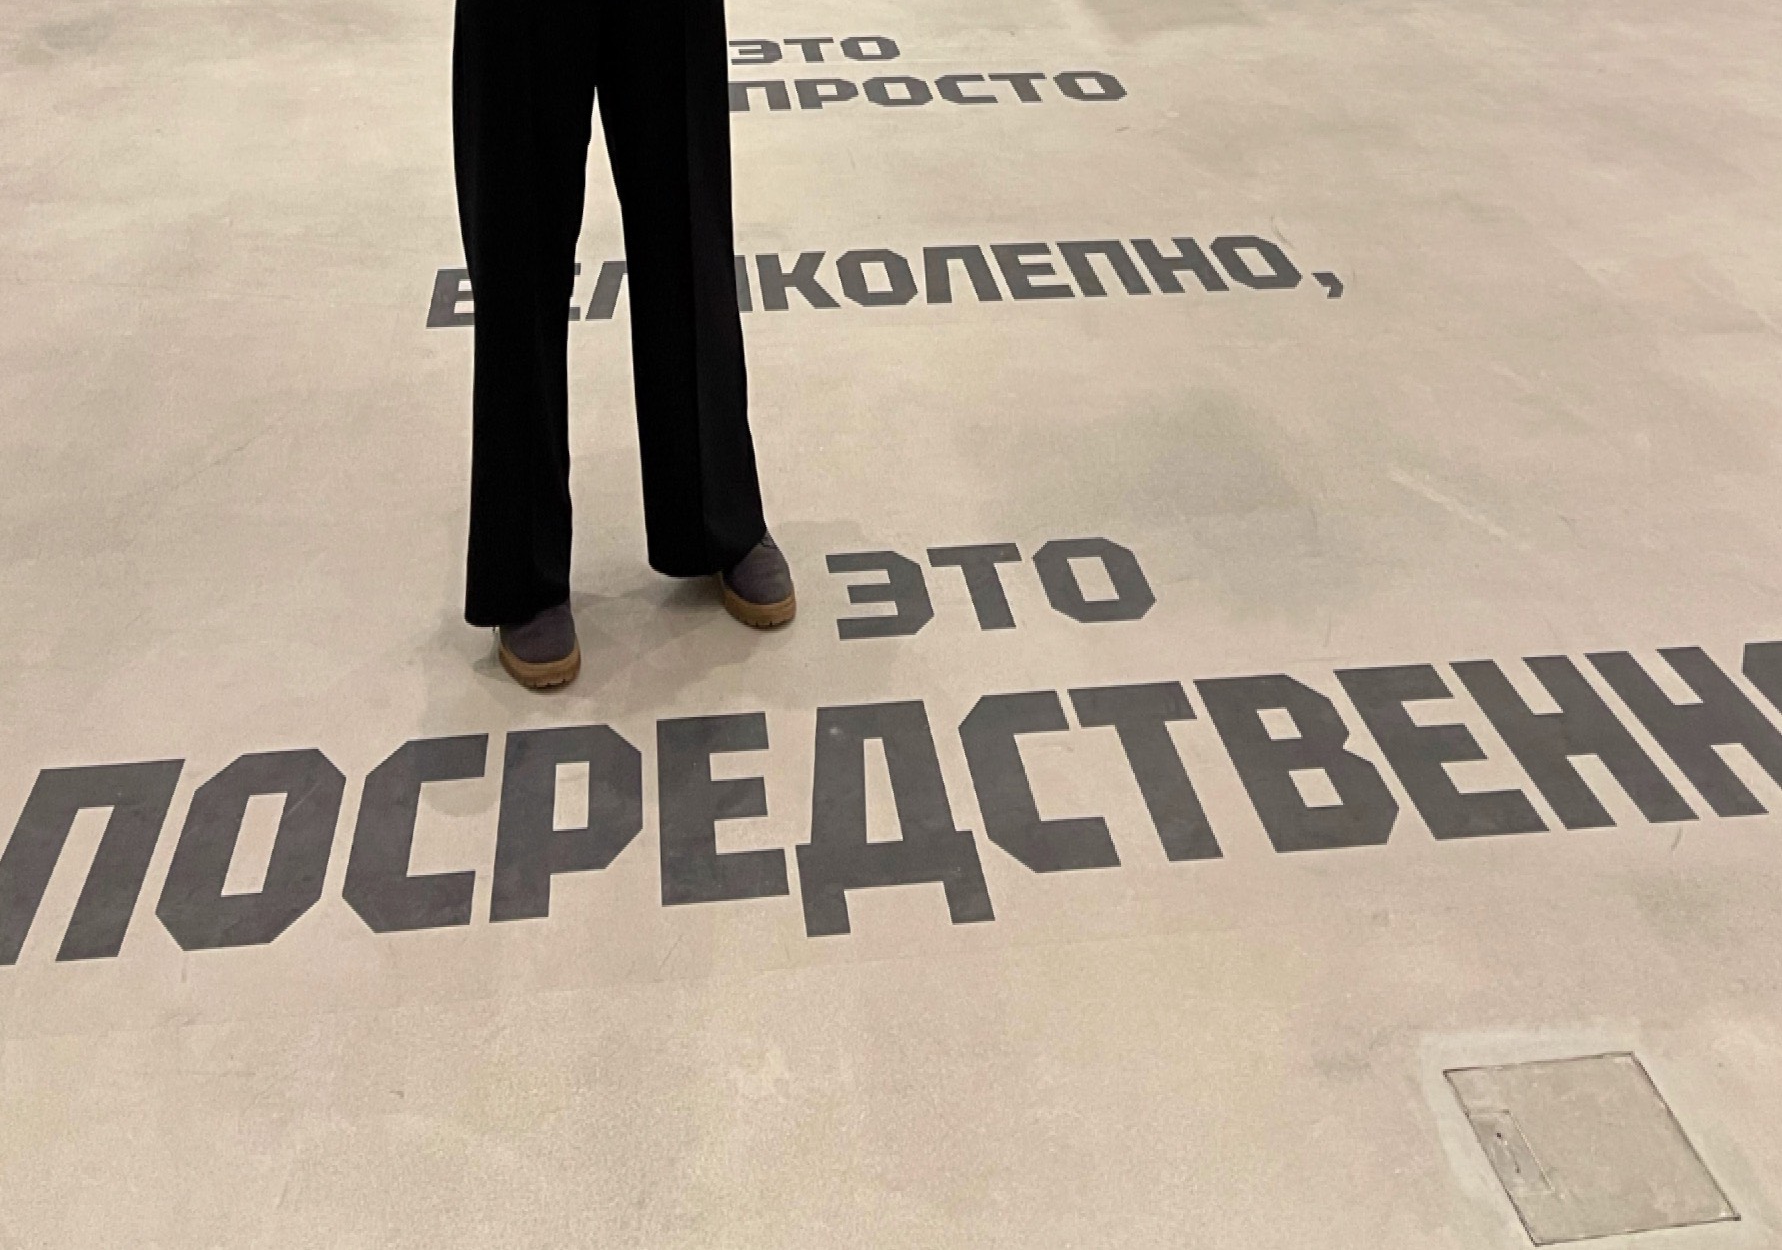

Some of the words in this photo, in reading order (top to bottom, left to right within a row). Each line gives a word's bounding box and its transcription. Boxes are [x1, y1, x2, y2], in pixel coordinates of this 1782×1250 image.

[728, 36, 901, 65] ЭТО
[728, 70, 1128, 112] ПРОСТО
[825, 537, 1157, 641] ЭТО
[0, 640, 1782, 964] ПОСРЕДСТВЕНН
